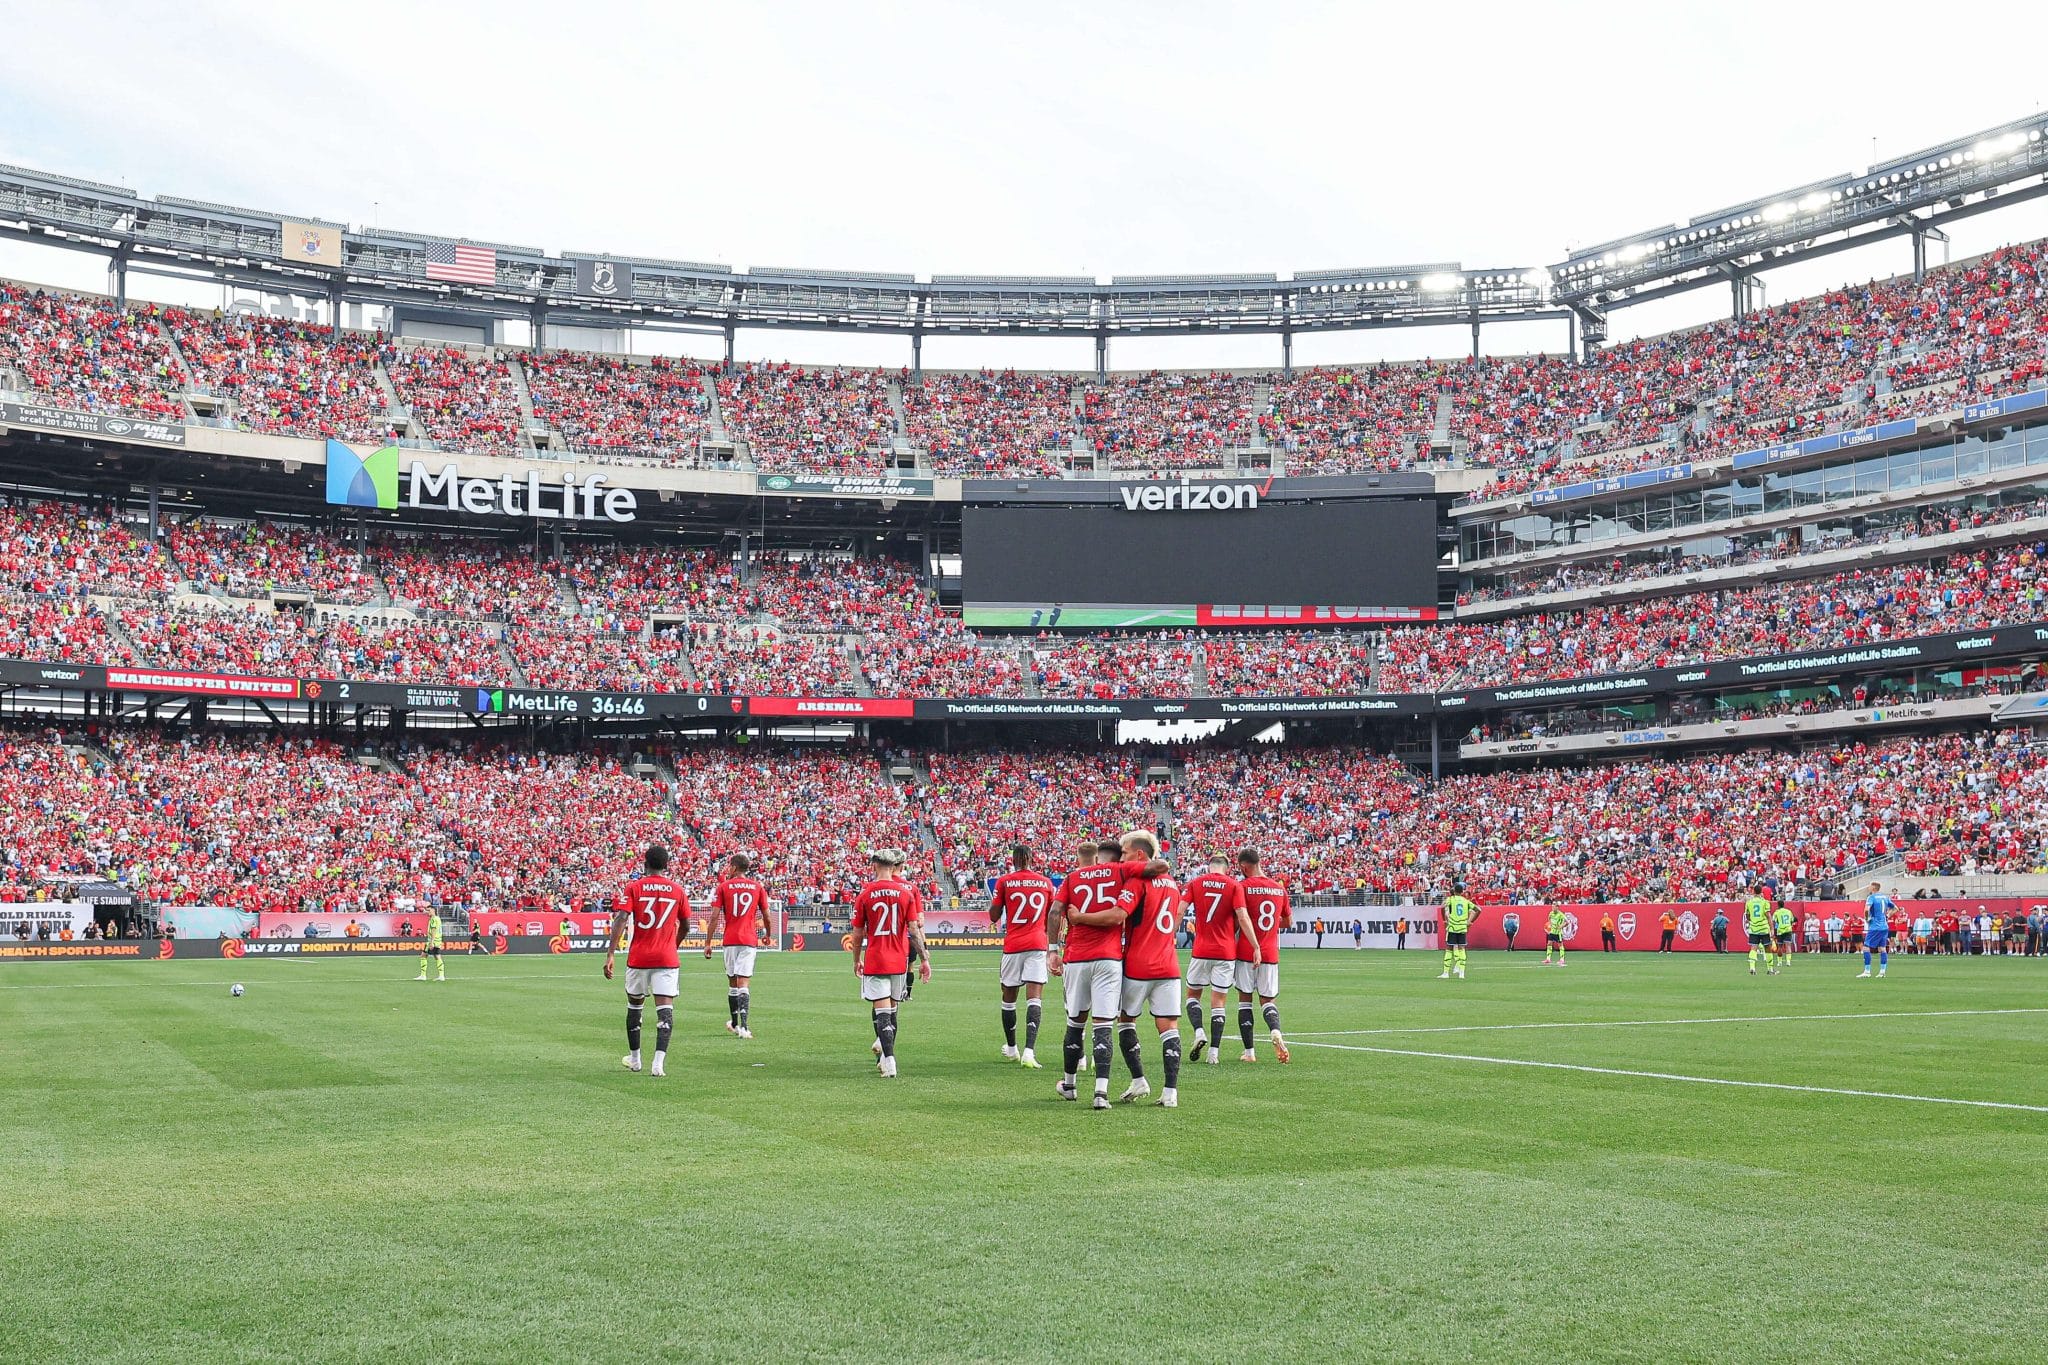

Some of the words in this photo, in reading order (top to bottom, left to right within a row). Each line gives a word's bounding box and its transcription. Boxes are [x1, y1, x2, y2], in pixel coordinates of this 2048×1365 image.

[19, 407, 37, 416] Text
[74, 415, 98, 424] 78247
[1968, 409, 1978, 418] 32
[30, 417, 44, 425] call
[133, 423, 169, 434] FANS
[144, 431, 184, 442] FIRST
[1842, 435, 1848, 444] 4
[1849, 433, 1874, 445] LEEMANS
[1780, 448, 1800, 458] STRONG
[1665, 470, 1669, 478] 7
[794, 476, 843, 486] SUPER
[844, 478, 882, 487] BOWL
[884, 479, 901, 487] III
[409, 461, 637, 523] MetLife
[832, 485, 916, 496] CHAMPIONS
[1120, 478, 1257, 511] verizon
[2035, 630, 2048, 640] Th
[1956, 637, 1992, 650] verizon
[1741, 665, 1757, 676] The
[1758, 661, 1787, 674] Official
[1788, 660, 1800, 670] 5G
[1801, 656, 1838, 668] Network
[1838, 654, 1848, 664] of
[1848, 650, 1880, 663] MetLife
[1881, 645, 1921, 658] Stadium.
[41, 669, 80, 681] verizon
[1676, 672, 1706, 682] verizon
[109, 673, 226, 690] MANCHESTER
[229, 680, 292, 693] UNITED
[339, 684, 350, 698] 2
[407, 688, 424, 696] OLD
[1495, 692, 1508, 702] The
[1509, 689, 1534, 700] Official
[1534, 688, 1545, 698] 5G
[1546, 686, 1576, 697] Network
[1577, 684, 1586, 694] of
[1586, 682, 1614, 693] MetLife
[1614, 678, 1648, 690] Stadium.
[407, 695, 432, 706] NEW
[432, 696, 462, 708] YORK.
[508, 690, 578, 712] MetLife
[591, 697, 646, 715] 36:46
[698, 698, 708, 711] 0
[796, 702, 864, 712] ARSENAL
[1221, 703, 1238, 712] The
[1238, 702, 1268, 712] Official
[1268, 703, 1280, 712] 5G
[1282, 702, 1317, 712] Network
[1318, 702, 1328, 710] of
[1328, 702, 1360, 710] MetLife
[1360, 700, 1398, 710] Stadium.
[1440, 697, 1466, 706] verizon
[947, 704, 963, 713] The
[964, 704, 994, 713] Official
[994, 704, 1007, 713] 5G
[1008, 704, 1042, 713] Network
[1044, 704, 1053, 713] of
[1053, 704, 1084, 714] MetLife
[1085, 704, 1122, 714] Stadium.
[1154, 704, 1184, 713] verizon
[1886, 708, 1918, 719] MetLife
[1623, 731, 1665, 744] HCLTech
[1507, 743, 1538, 753] verizon
[1080, 868, 1112, 880] SANCHO
[642, 883, 672, 893] MAINOO
[1006, 880, 1048, 889] WAN-BISSAKA
[1202, 880, 1226, 890] MOUNT
[870, 889, 900, 899] ANTONY
[1074, 881, 1118, 914] 25
[80, 896, 98, 905] TLIFE
[100, 896, 132, 906] STADIUM
[732, 892, 753, 918] 19
[1882, 900, 1885, 914] 1
[638, 897, 676, 930] 37
[1010, 892, 1045, 924] 29
[1205, 892, 1222, 923] 7
[1456, 903, 1464, 916] 6
[1754, 904, 1760, 917] 2
[872, 902, 898, 936] 21
[1156, 896, 1174, 934] 6
[1258, 900, 1276, 932] 8
[1781, 914, 1790, 924] 12
[1278, 921, 1307, 934] LD
[266, 944, 282, 952] 27
[284, 944, 300, 952] AT
[302, 943, 350, 952] DIGNITY
[352, 942, 396, 951] HEALTH
[446, 942, 475, 950] PAR
[590, 940, 604, 948] 27
[945, 938, 982, 946] HEALTH
[48, 946, 102, 956] SPORTS
[104, 946, 140, 955] PARK
